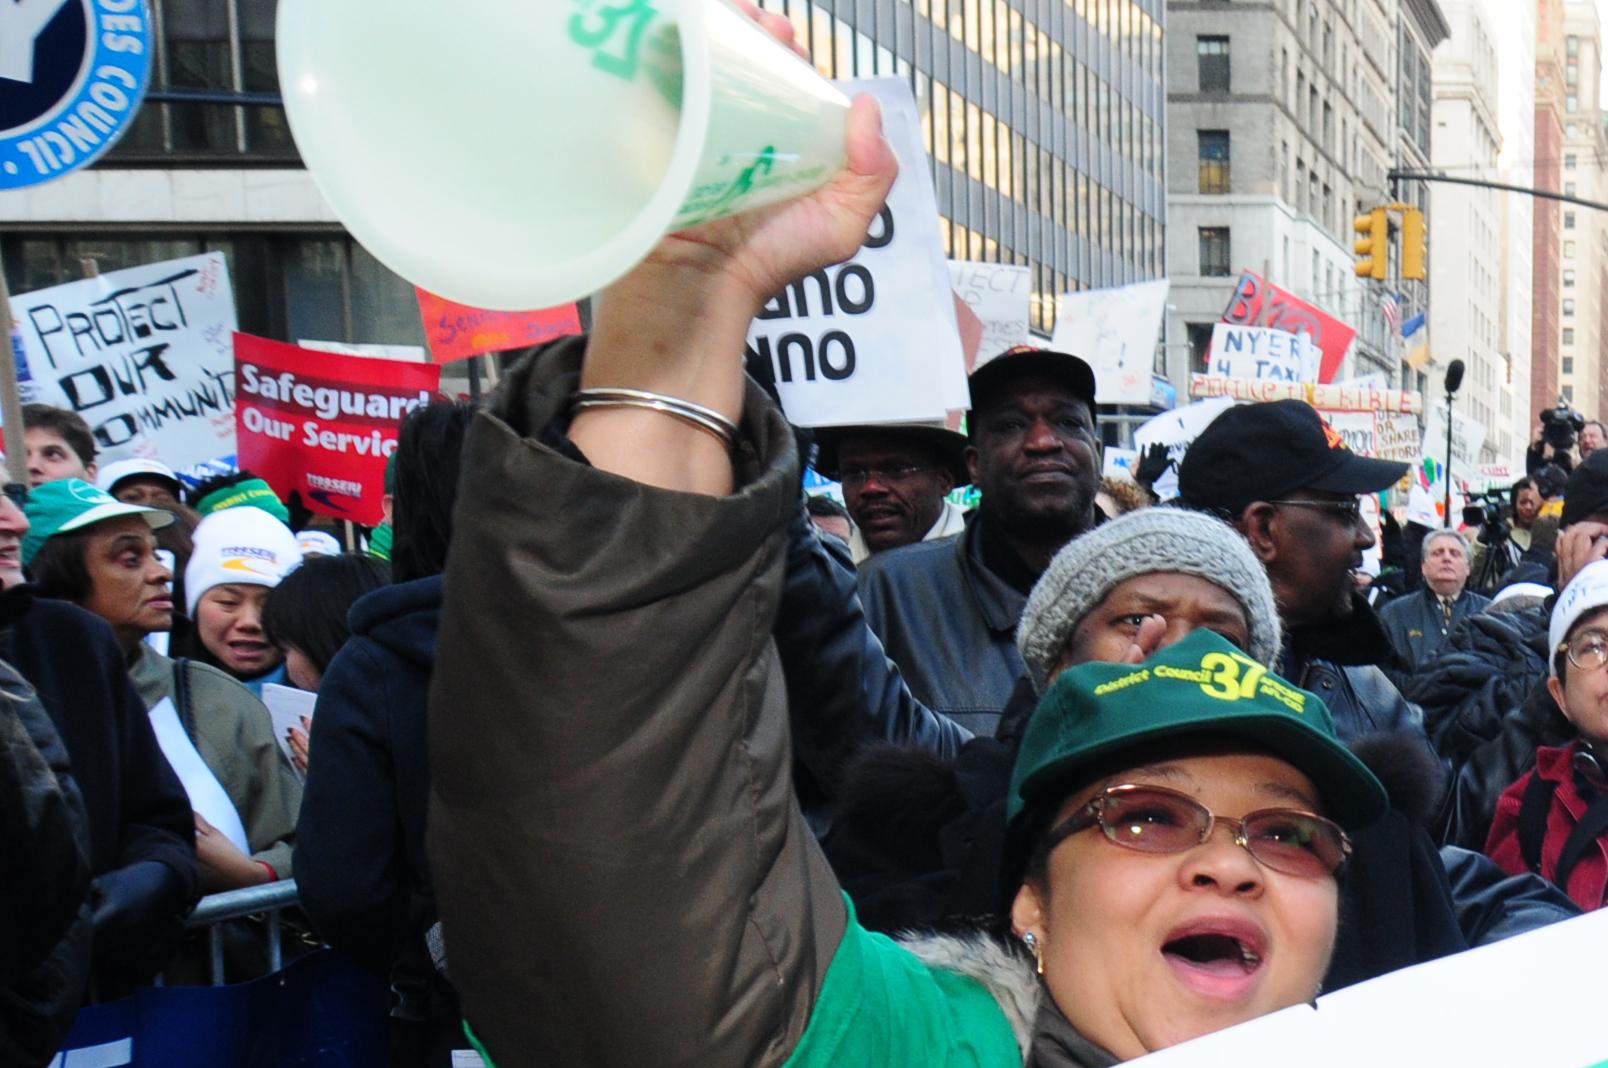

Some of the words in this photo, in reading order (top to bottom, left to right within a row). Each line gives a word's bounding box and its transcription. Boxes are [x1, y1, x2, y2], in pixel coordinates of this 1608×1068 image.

[17, 65, 137, 175] COUNCIL
[28, 269, 198, 370] PROTECT
[59, 343, 176, 411] OUR
[756, 331, 855, 382] OU
[242, 363, 429, 420] Safeguard
[242, 407, 295, 441] Our
[303, 421, 398, 457] Servic
[1200, 651, 1267, 702] 37
